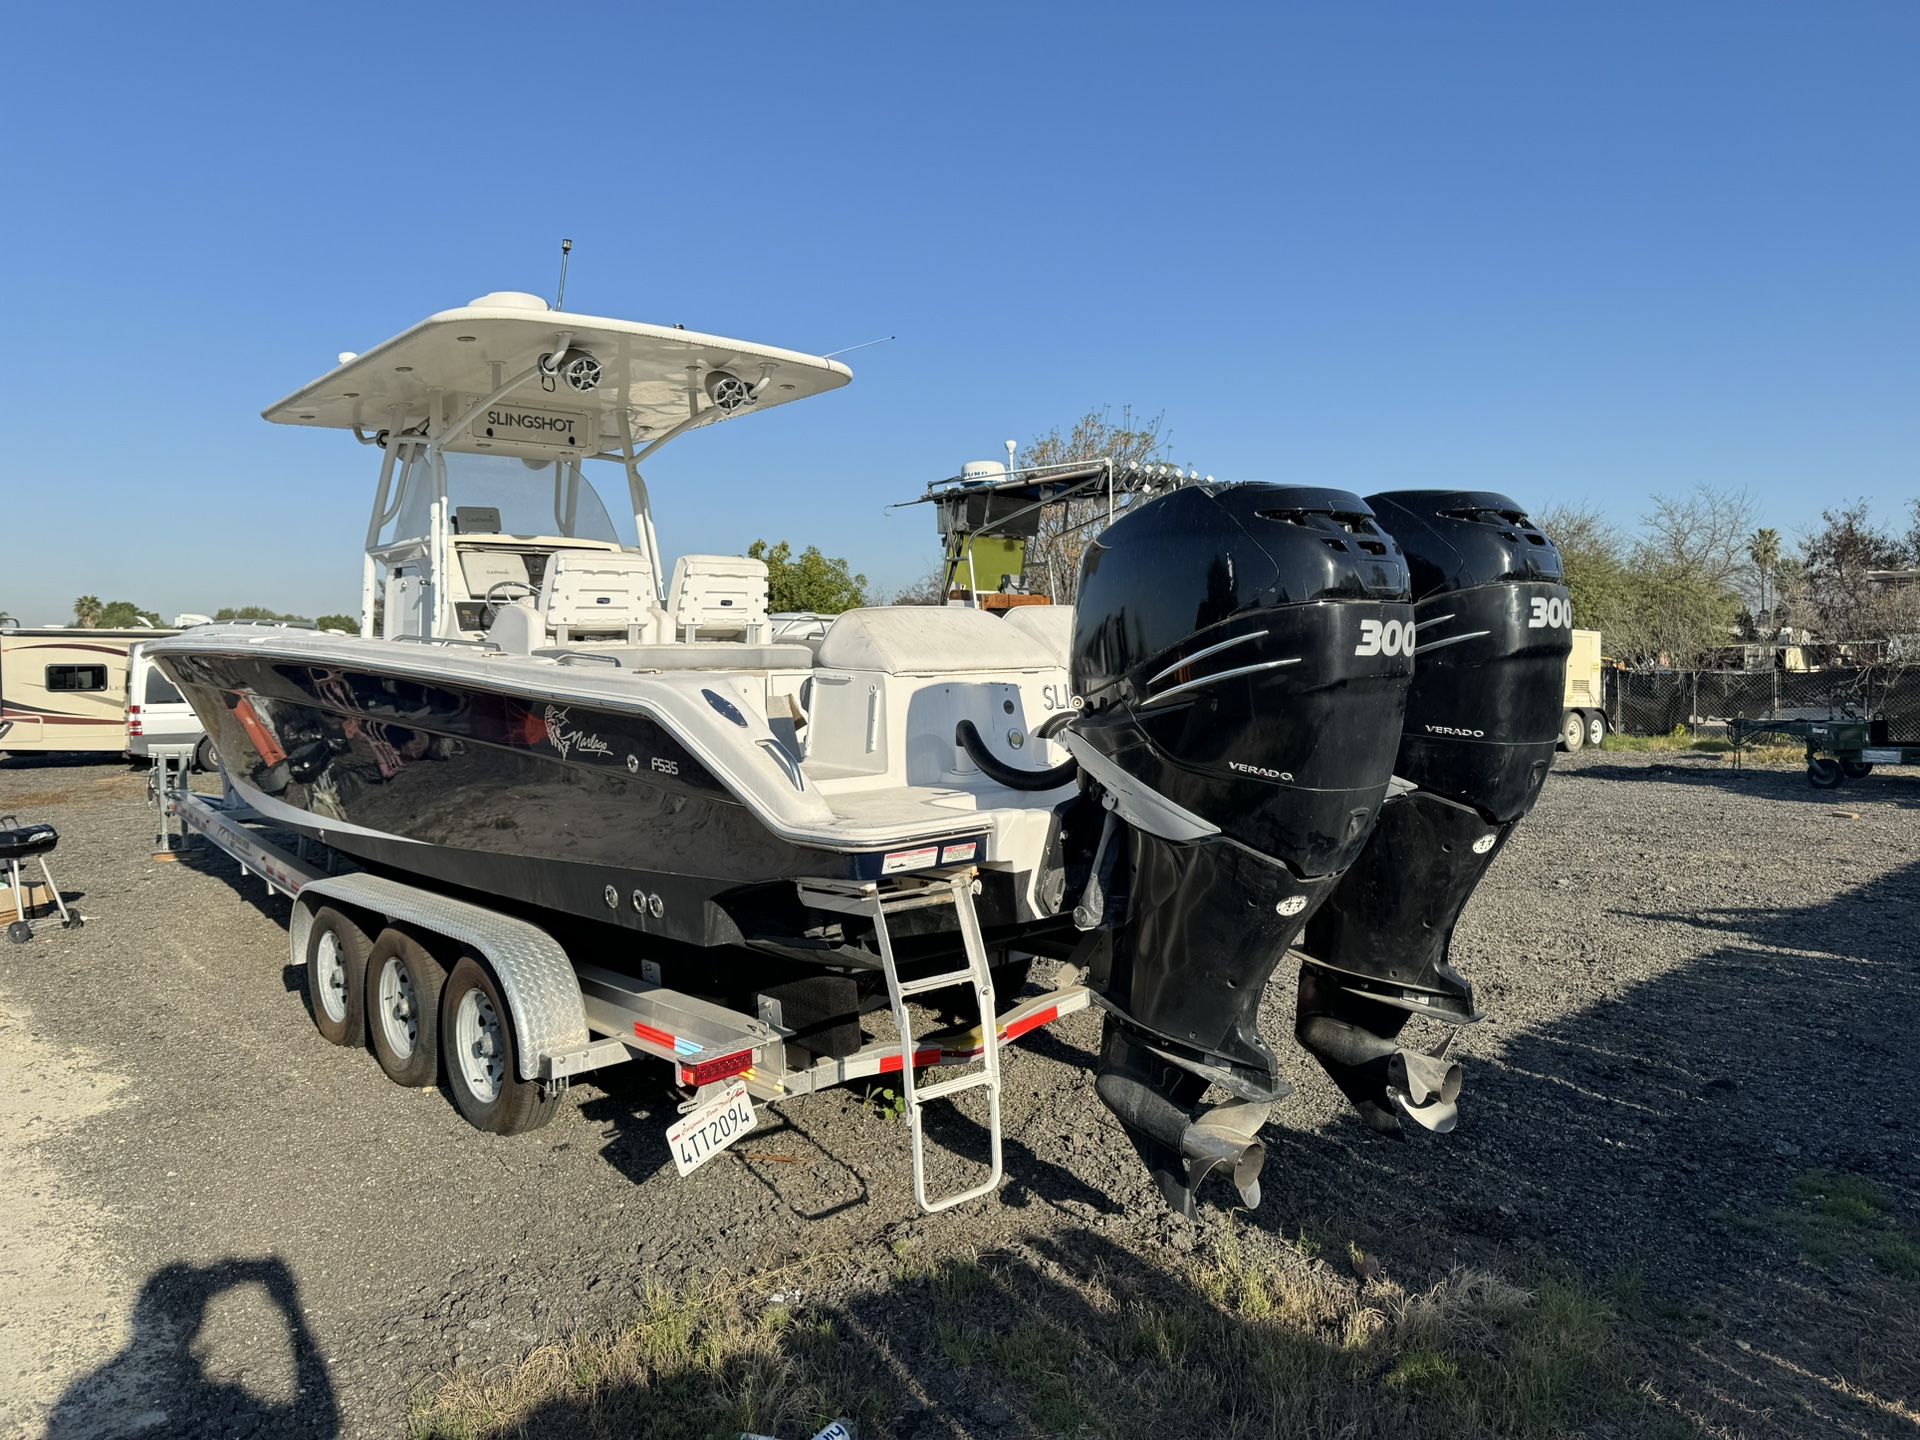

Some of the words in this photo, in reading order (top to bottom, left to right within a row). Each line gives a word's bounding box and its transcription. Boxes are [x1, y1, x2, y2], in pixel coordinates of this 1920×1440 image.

[487, 411, 575, 433] SLINGSHOT
[1528, 597, 1572, 629] 300
[1354, 619, 1416, 657] 300
[1425, 724, 1485, 738] VERADO
[561, 731, 613, 757] Marlago
[651, 757, 679, 775] FS35
[1228, 761, 1293, 781] VERADO
[680, 1103, 750, 1164] 4TT2094
